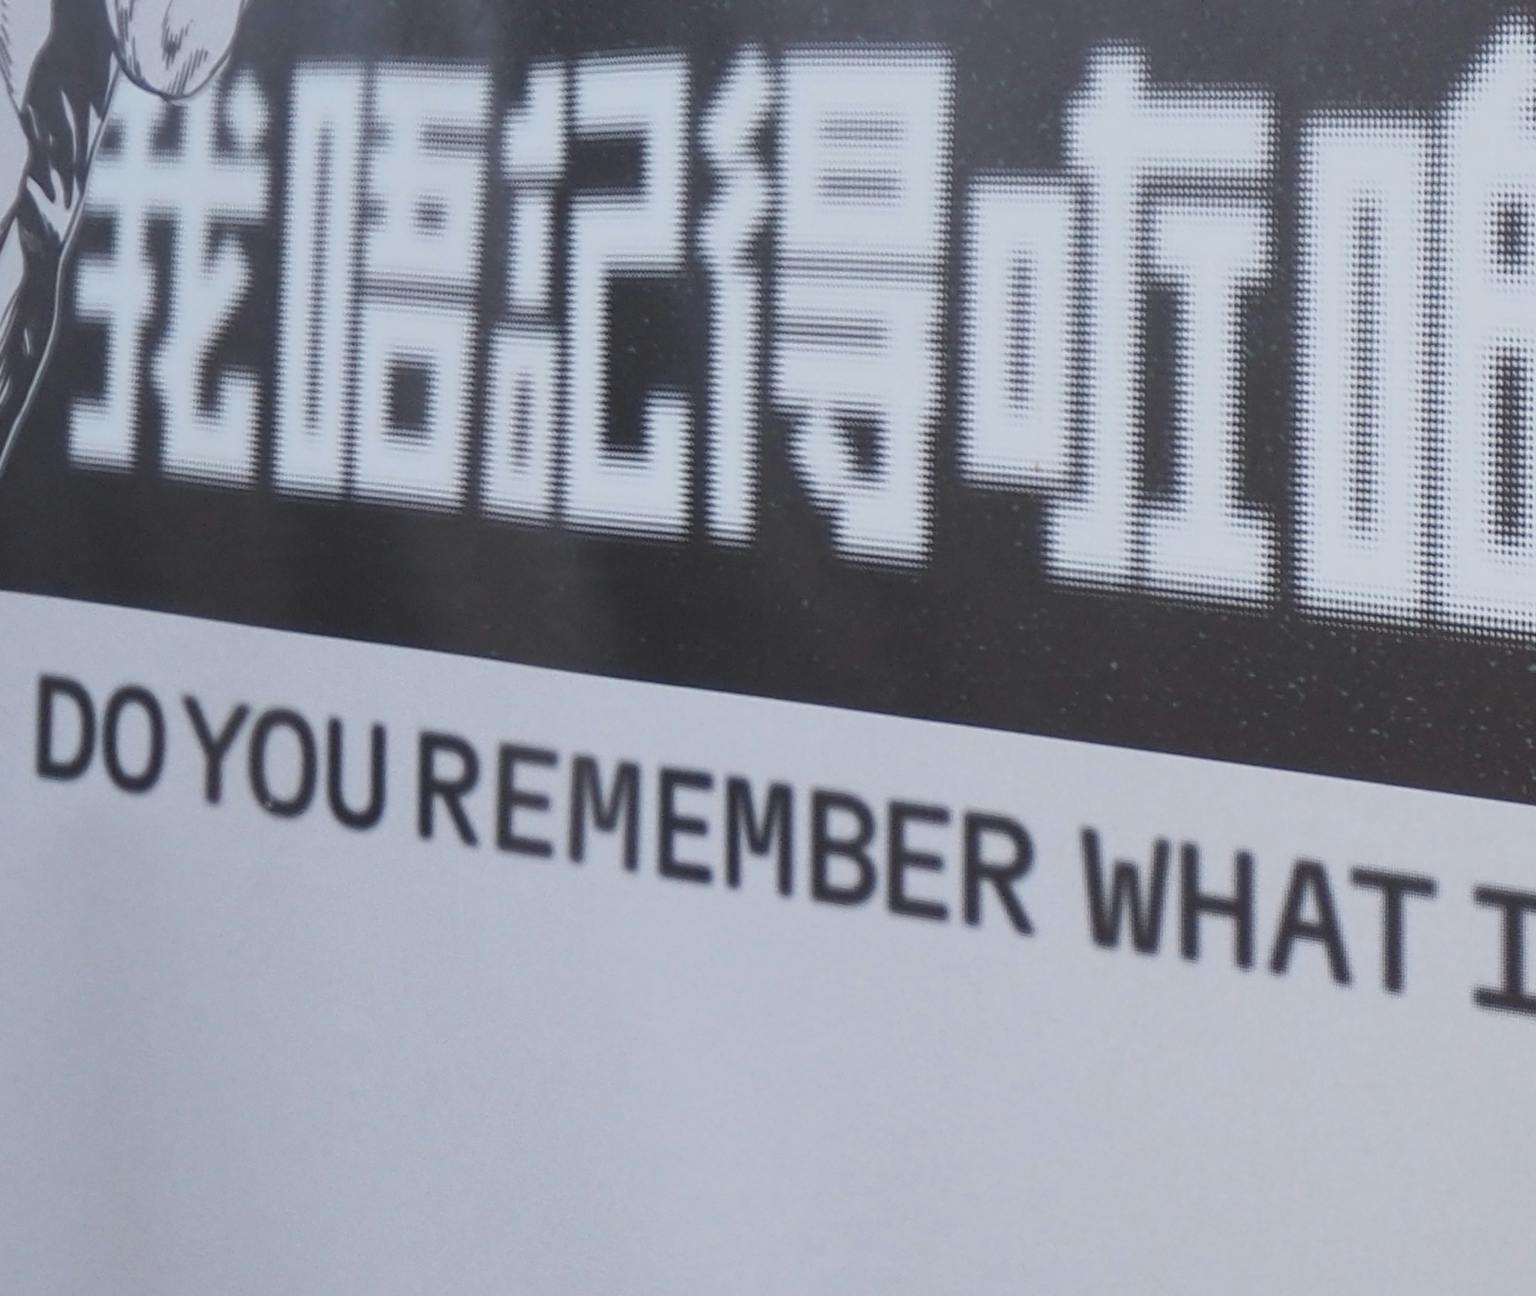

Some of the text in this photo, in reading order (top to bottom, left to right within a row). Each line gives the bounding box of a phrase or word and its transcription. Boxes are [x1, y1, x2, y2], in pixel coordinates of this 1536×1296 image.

[35, 673, 167, 795] DO
[181, 694, 387, 833] YOU
[416, 731, 1036, 937] REMEMBER
[1079, 826, 1438, 996] WHAT
